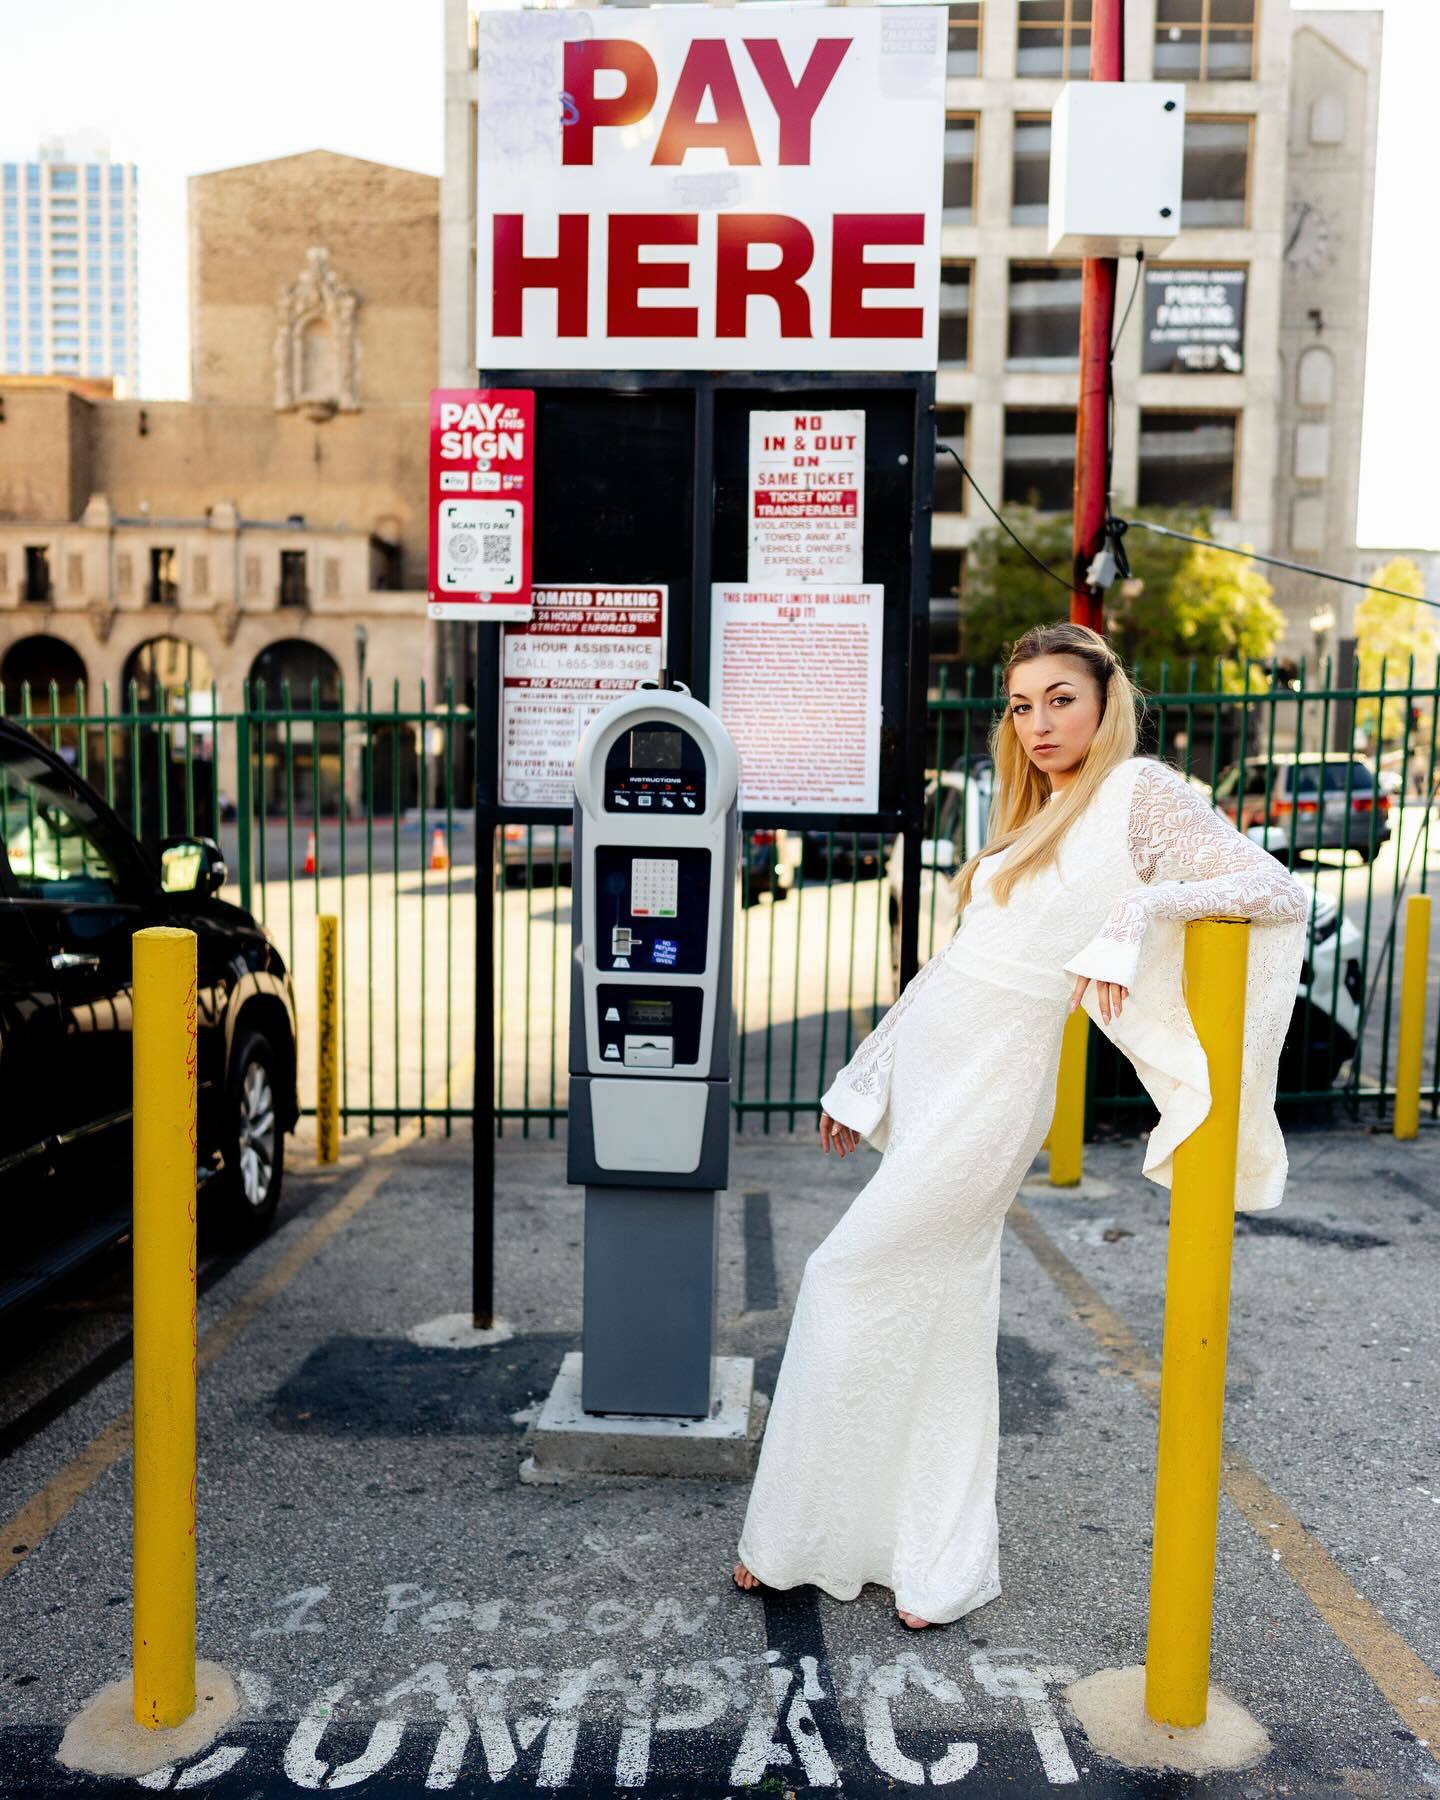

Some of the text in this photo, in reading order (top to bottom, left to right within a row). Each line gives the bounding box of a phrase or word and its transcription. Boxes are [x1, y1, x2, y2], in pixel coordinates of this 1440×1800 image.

[562, 38, 854, 166] PAY
[492, 213, 926, 338] HERE
[1156, 306, 1235, 326] PARKING
[440, 403, 520, 431] PAY AT
[498, 418, 525, 430] THIS
[795, 416, 822, 431] NO
[440, 432, 524, 460] SIGN
[764, 436, 857, 450] IN & OUT
[793, 456, 820, 467] ON
[757, 472, 855, 486] SAME TICKET
[769, 492, 843, 504] TICKET NOT
[757, 505, 855, 516] TRANSFERABLE
[451, 522, 511, 531] SCAN TO PAY
[754, 521, 857, 529] VIOLATORS WILL BE
[764, 532, 847, 541] TOWED AWAY AT
[760, 544, 801, 553] VEHICLE
[531, 591, 659, 607] TOMATED PARKING
[723, 592, 740, 603] THIS
[743, 592, 783, 603] CONTRACT
[786, 592, 813, 603] LIMITS
[832, 593, 871, 604] LIABILITY
[538, 611, 550, 621] 24
[551, 611, 584, 622] HOURS
[586, 612, 593, 621] 7
[594, 612, 618, 622] DAYS
[618, 612, 627, 622] A
[628, 612, 656, 623] WEEK
[777, 607, 801, 617] READ
[530, 623, 637, 633] STRICTLY ENFORCED
[512, 642, 653, 654] 24 HOUR ASSISTANCE
[530, 678, 635, 690] NO CHANGE GIVEN
[507, 760, 546, 768] VIOLATORS
